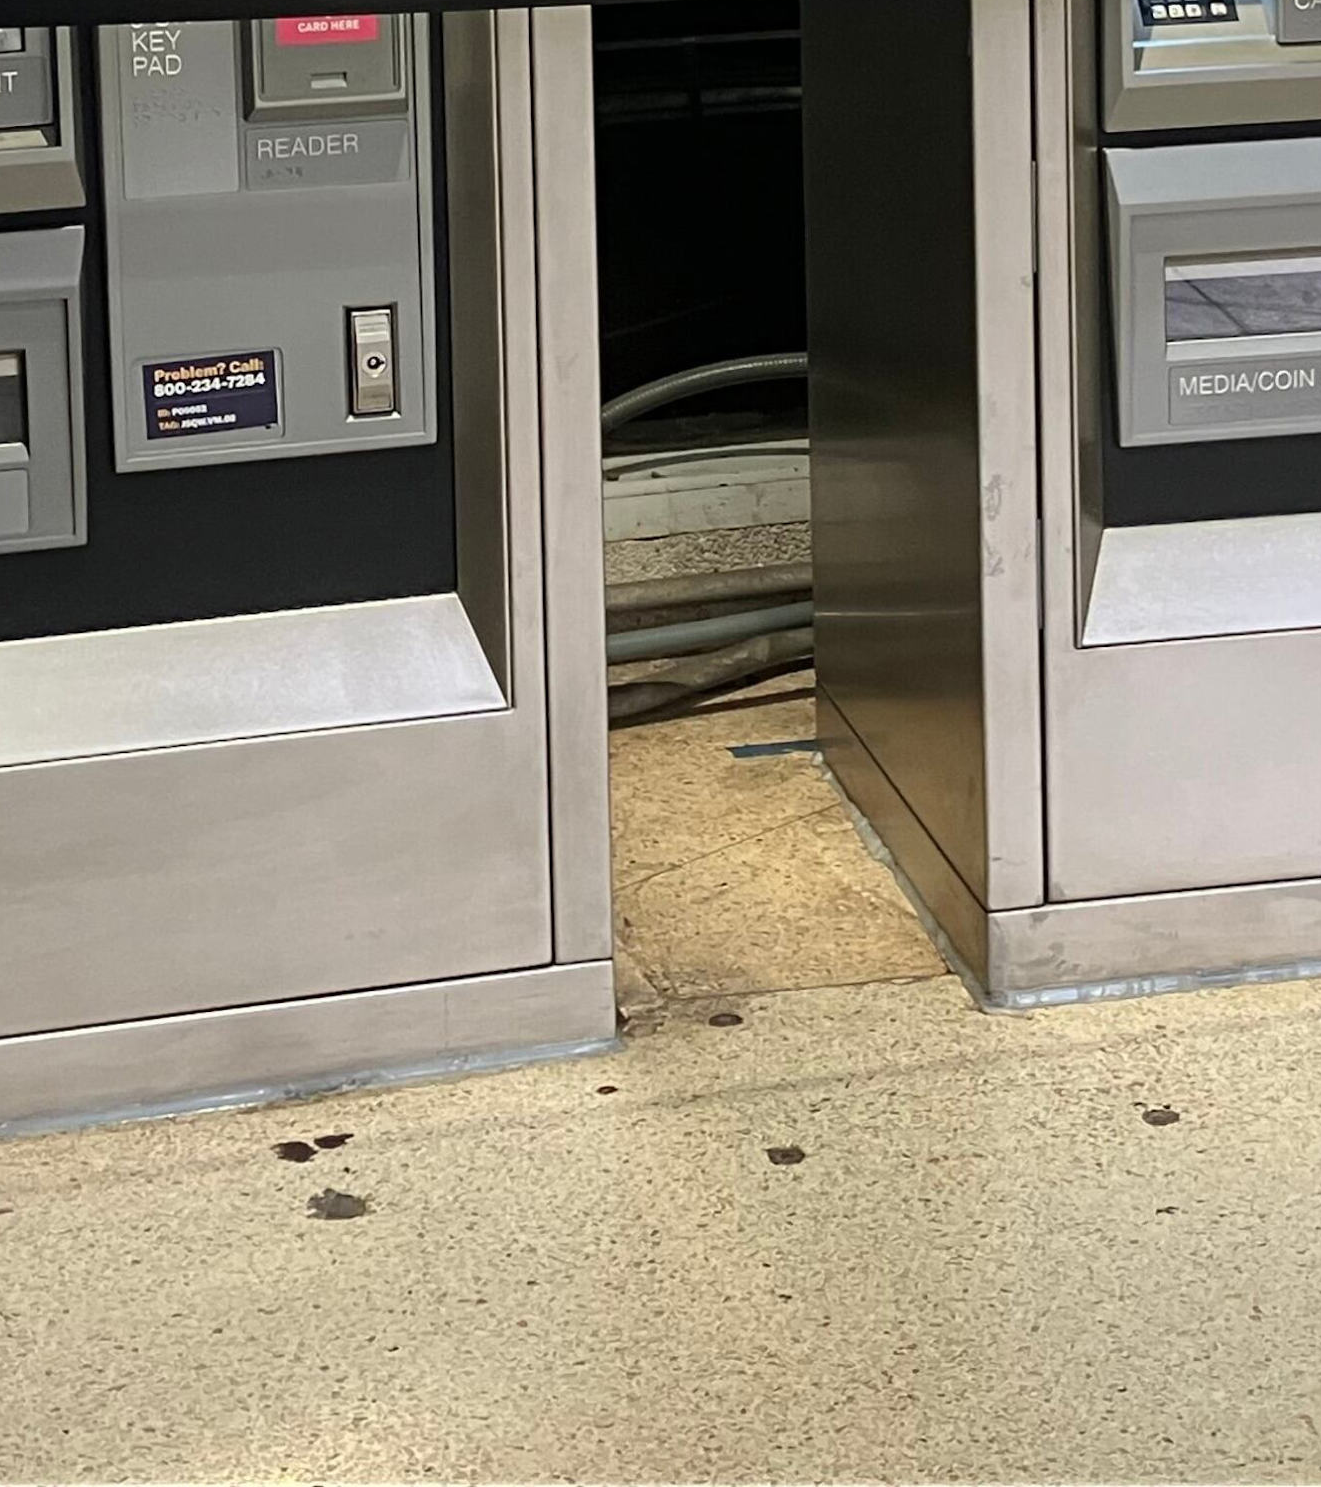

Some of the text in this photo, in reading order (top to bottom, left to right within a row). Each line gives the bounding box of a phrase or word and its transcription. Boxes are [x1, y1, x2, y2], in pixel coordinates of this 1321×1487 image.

[298, 20, 359, 32] CARD HERE
[132, 30, 180, 52] KEY
[132, 55, 181, 76] PAD
[256, 134, 358, 159] READER
[154, 358, 264, 382] Problem? Call:
[1180, 369, 1314, 395] MEDIA/COIN
[154, 373, 265, 397] 800-234-7284
